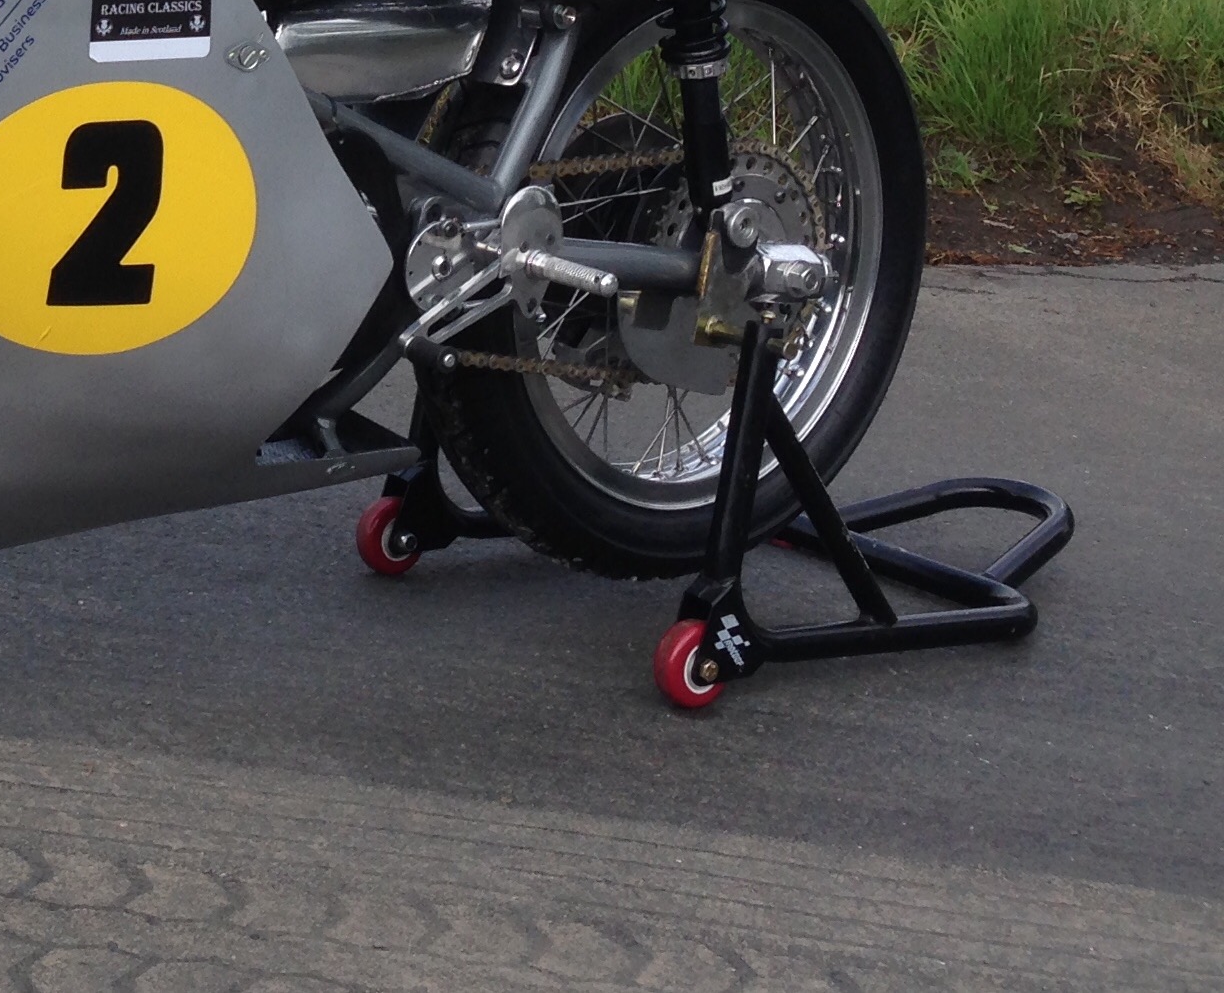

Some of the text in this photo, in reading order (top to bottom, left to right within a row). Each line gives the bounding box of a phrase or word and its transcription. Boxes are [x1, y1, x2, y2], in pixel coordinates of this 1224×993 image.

[100, 0, 203, 16] RACING CLASSICS
[120, 24, 182, 36] Made in Scotland
[46, 120, 164, 306] 2
